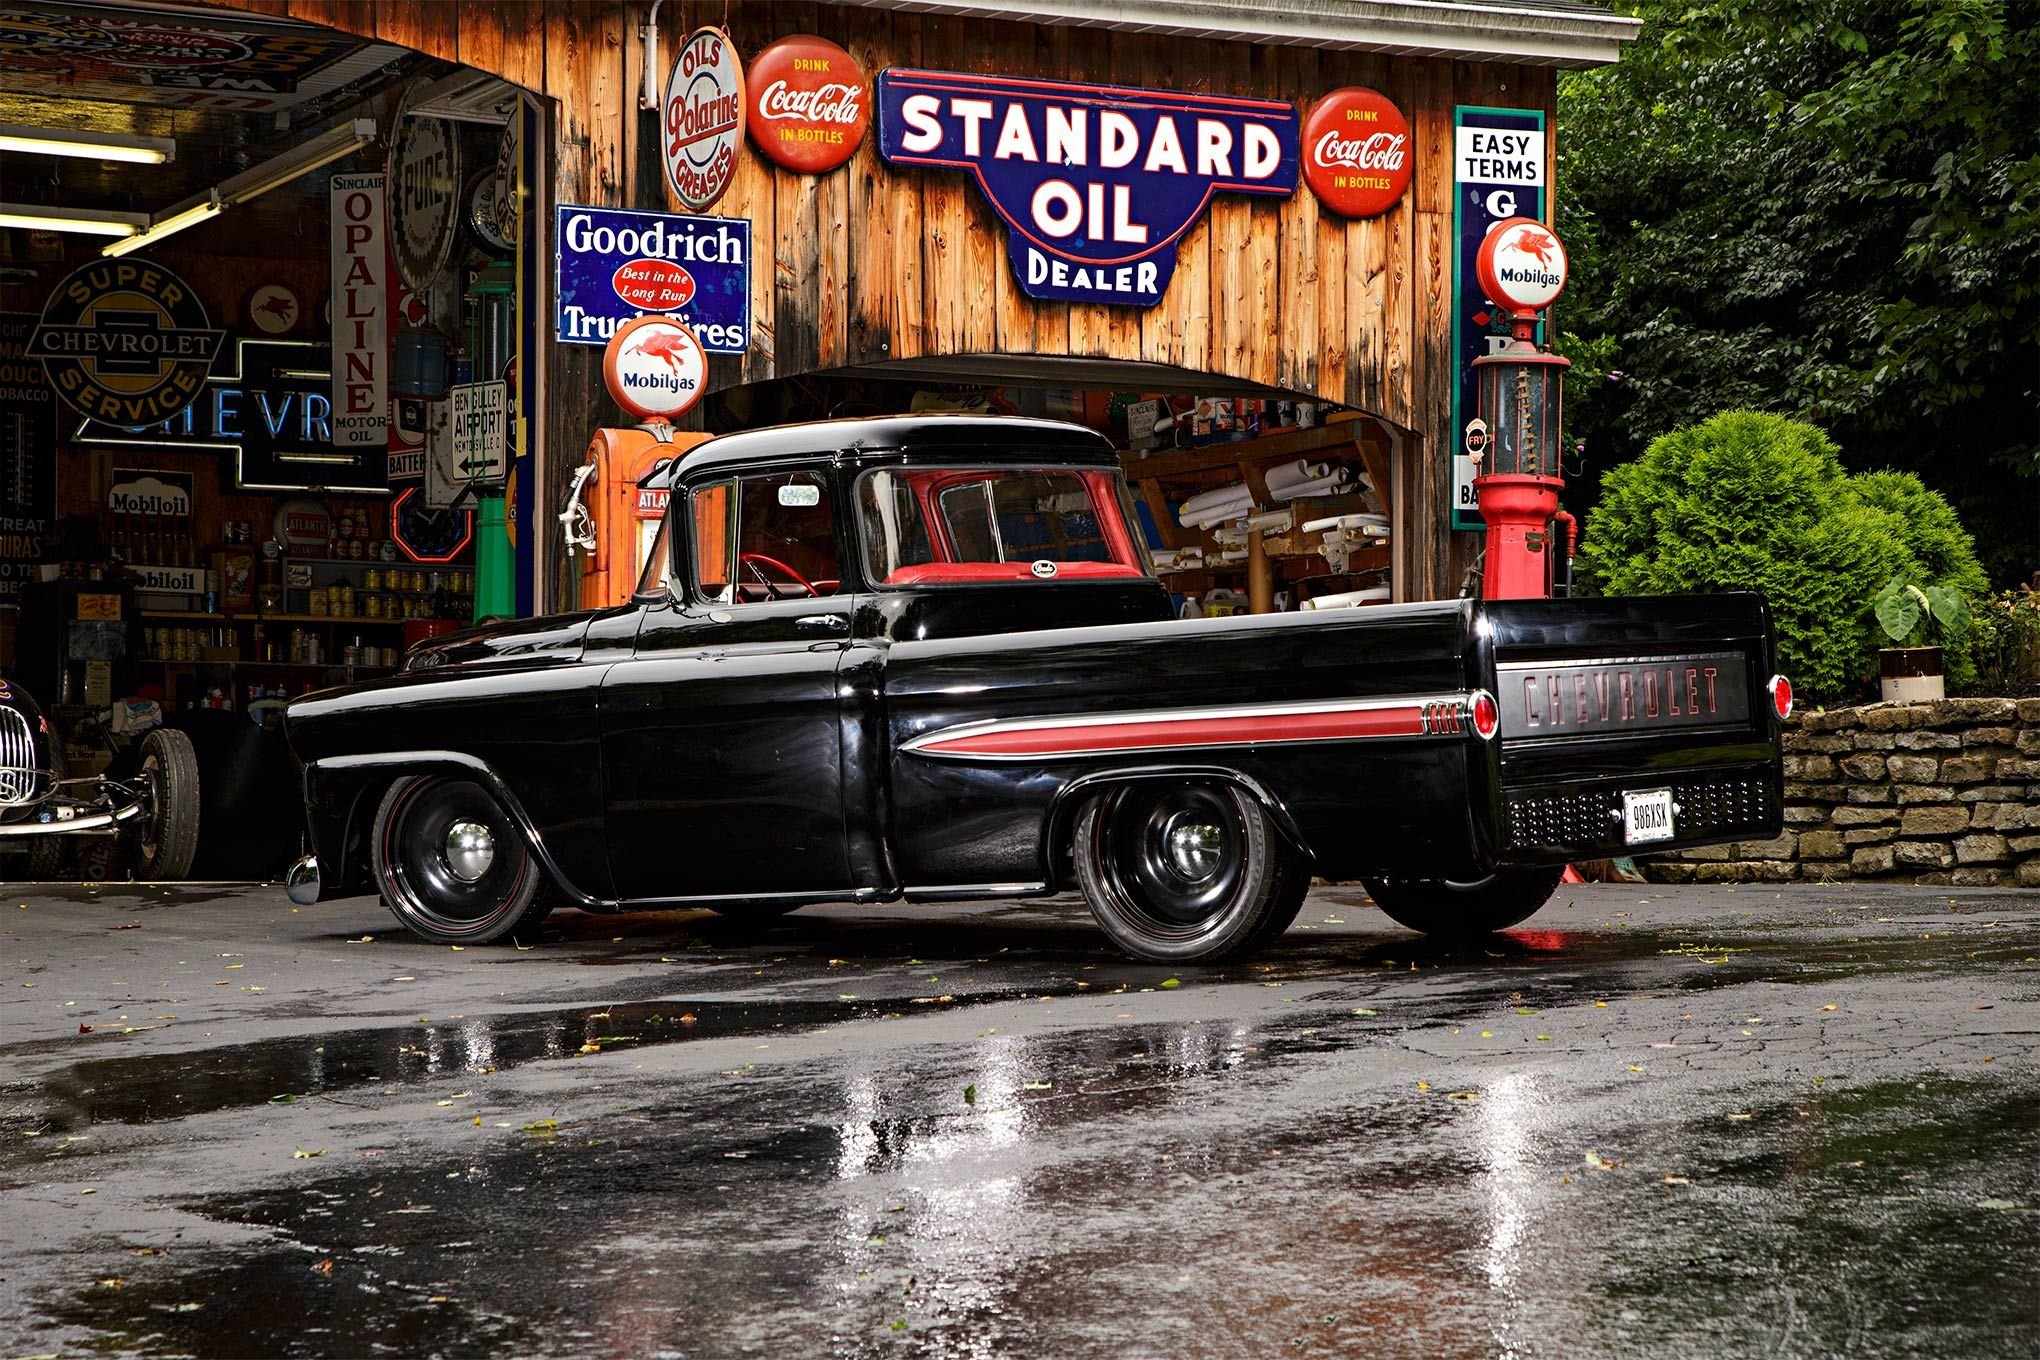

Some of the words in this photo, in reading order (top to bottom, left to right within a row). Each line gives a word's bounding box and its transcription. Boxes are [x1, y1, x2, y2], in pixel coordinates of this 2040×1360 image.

[682, 38, 722, 78] OILS
[794, 58, 830, 72] DRINK
[759, 80, 862, 124] Coca-Cola
[667, 87, 738, 157] Polarine
[1346, 109, 1378, 122] DRINK
[780, 129, 794, 141] IN
[797, 129, 843, 144] BOTTLES
[901, 94, 1281, 180] STANDARD
[1472, 134, 1530, 156] EASY
[497, 130, 513, 181] RED
[1314, 130, 1407, 171] Coca-Cola
[332, 173, 384, 190] SINCLAIR
[675, 142, 732, 200] GREASES
[1465, 157, 1537, 180] TERMS
[405, 150, 444, 216] PURE
[1335, 176, 1346, 188] IN
[1349, 177, 1391, 190] BOTTLES
[1031, 178, 1148, 244] OIL
[566, 214, 743, 264] Goodrich
[621, 267, 650, 281] Best
[652, 271, 665, 282] in
[668, 272, 688, 284] the
[1027, 247, 1158, 294] DEALER
[1500, 267, 1560, 288] Mobilgas
[67, 264, 184, 309] SUPER
[621, 285, 655, 301] Long
[660, 288, 687, 302] Run
[344, 192, 377, 413] OPALINE
[564, 305, 644, 338] Tru
[665, 311, 744, 347] ires
[42, 331, 211, 355] CHEVROLET
[58, 367, 197, 421] SERVICE
[623, 372, 695, 394] Mobilgas
[335, 416, 387, 428] MOTOR
[455, 410, 502, 438] AIRPORT
[349, 431, 373, 441] OIL
[1468, 435, 1485, 446] FRY
[112, 493, 186, 513] Mobiloil
[0, 517, 46, 532] REAT
[1523, 667, 1717, 727] CHEVROLET
